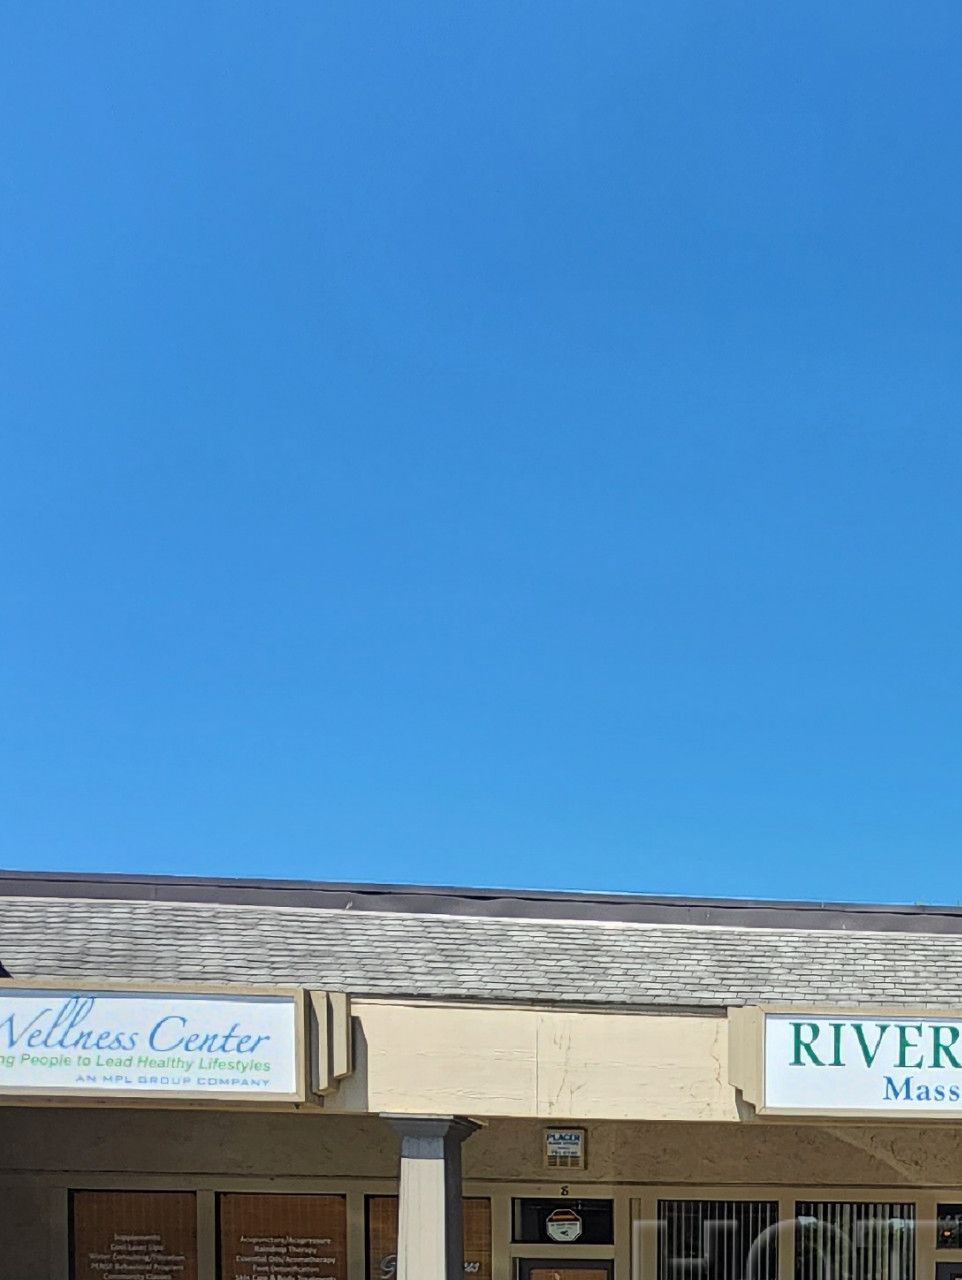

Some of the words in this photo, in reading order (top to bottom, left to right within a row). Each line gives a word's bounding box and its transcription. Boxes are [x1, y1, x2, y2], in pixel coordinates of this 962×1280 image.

[149, 1015, 271, 1053] Center
[20, 1053, 72, 1069] People
[77, 1056, 91, 1067] to
[96, 1055, 133, 1068] Lead
[137, 1056, 195, 1073] Healthy
[199, 1057, 271, 1073] Lifestyles
[103, 1075, 133, 1084] MPL
[138, 1076, 192, 1085] GROUP
[197, 1077, 272, 1086] COMPANY
